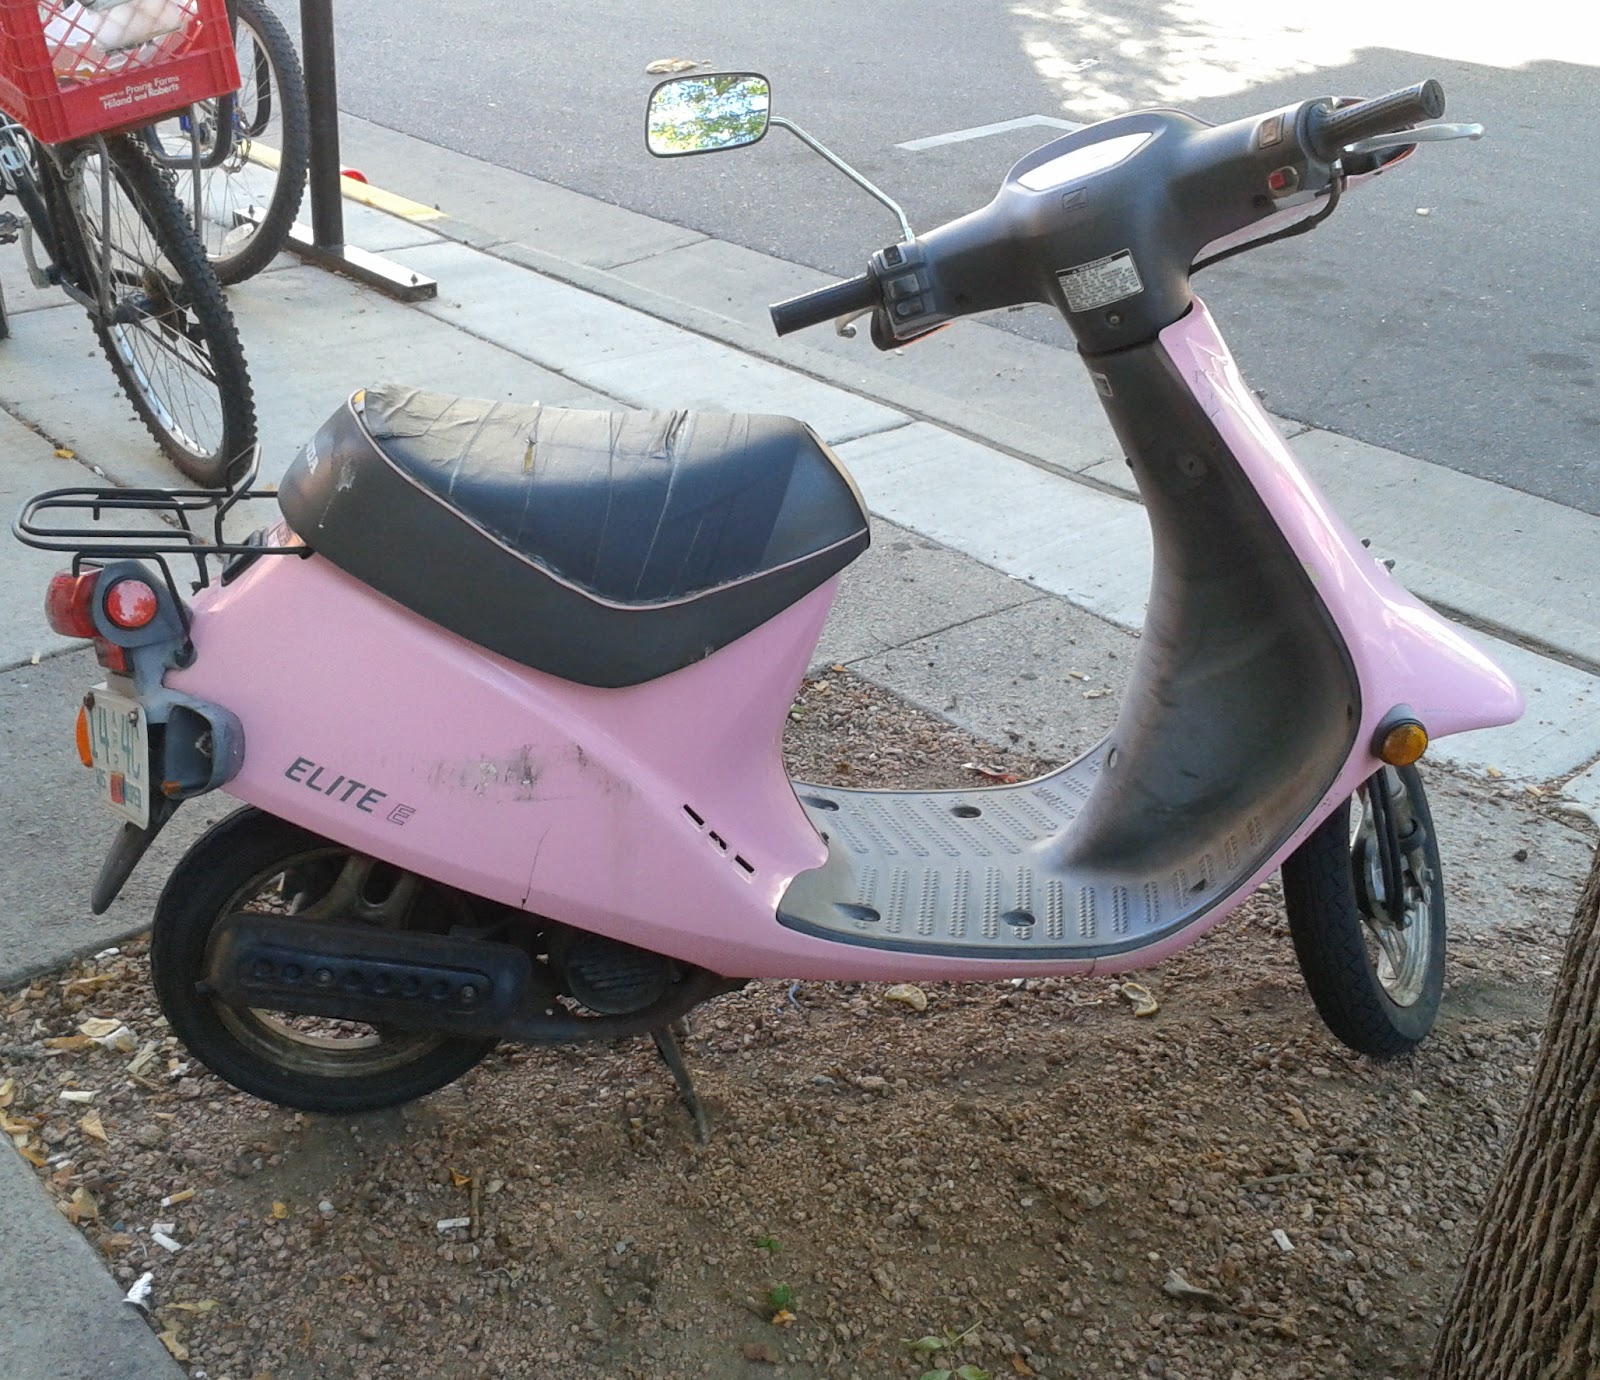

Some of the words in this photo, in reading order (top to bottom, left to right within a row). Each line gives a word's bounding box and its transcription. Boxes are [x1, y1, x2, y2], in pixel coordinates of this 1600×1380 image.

[103, 94, 132, 109] Hiland
[134, 92, 147, 101] and
[148, 83, 179, 97] Roberts
[126, 81, 152, 95] Prairie
[154, 76, 179, 87] Farms
[1079, 258, 1112, 272] WARNING
[285, 756, 388, 813] ELITE
[387, 803, 416, 826] E
